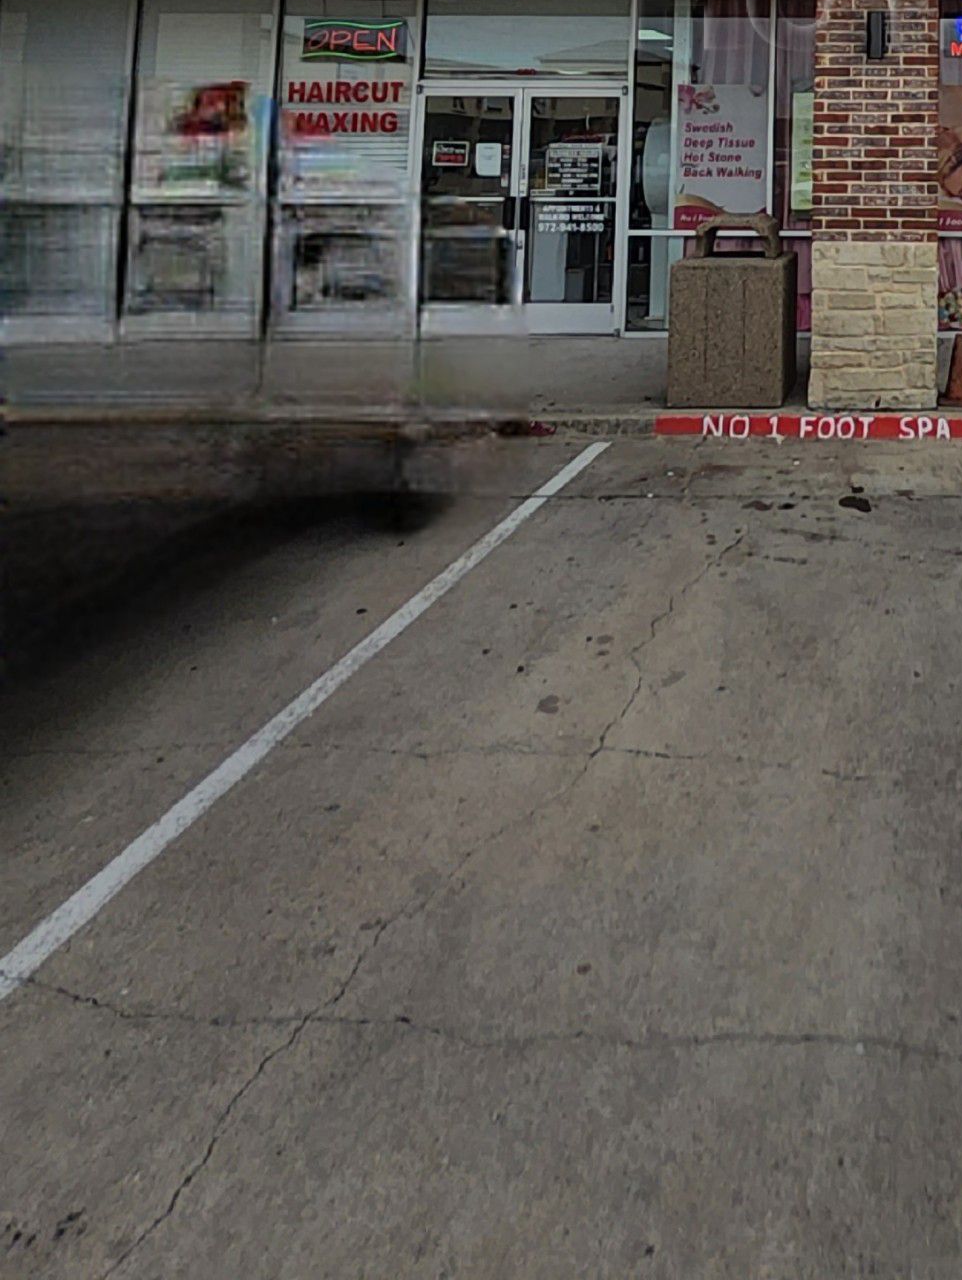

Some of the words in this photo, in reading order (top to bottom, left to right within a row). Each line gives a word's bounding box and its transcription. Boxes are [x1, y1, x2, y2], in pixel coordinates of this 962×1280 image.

[305, 28, 397, 52] OPEN
[288, 80, 405, 104] HAIRCUT
[684, 122, 733, 133] Swedish
[684, 137, 713, 149] Deep
[718, 137, 756, 148] Tissue
[683, 152, 704, 162] Hot
[708, 152, 742, 162] Stone
[683, 167, 713, 178] Back
[716, 167, 762, 179] Walking
[702, 415, 750, 439] NO
[768, 416, 783, 439] 1
[799, 416, 875, 439] FOOT
[899, 417, 951, 440] SPA
